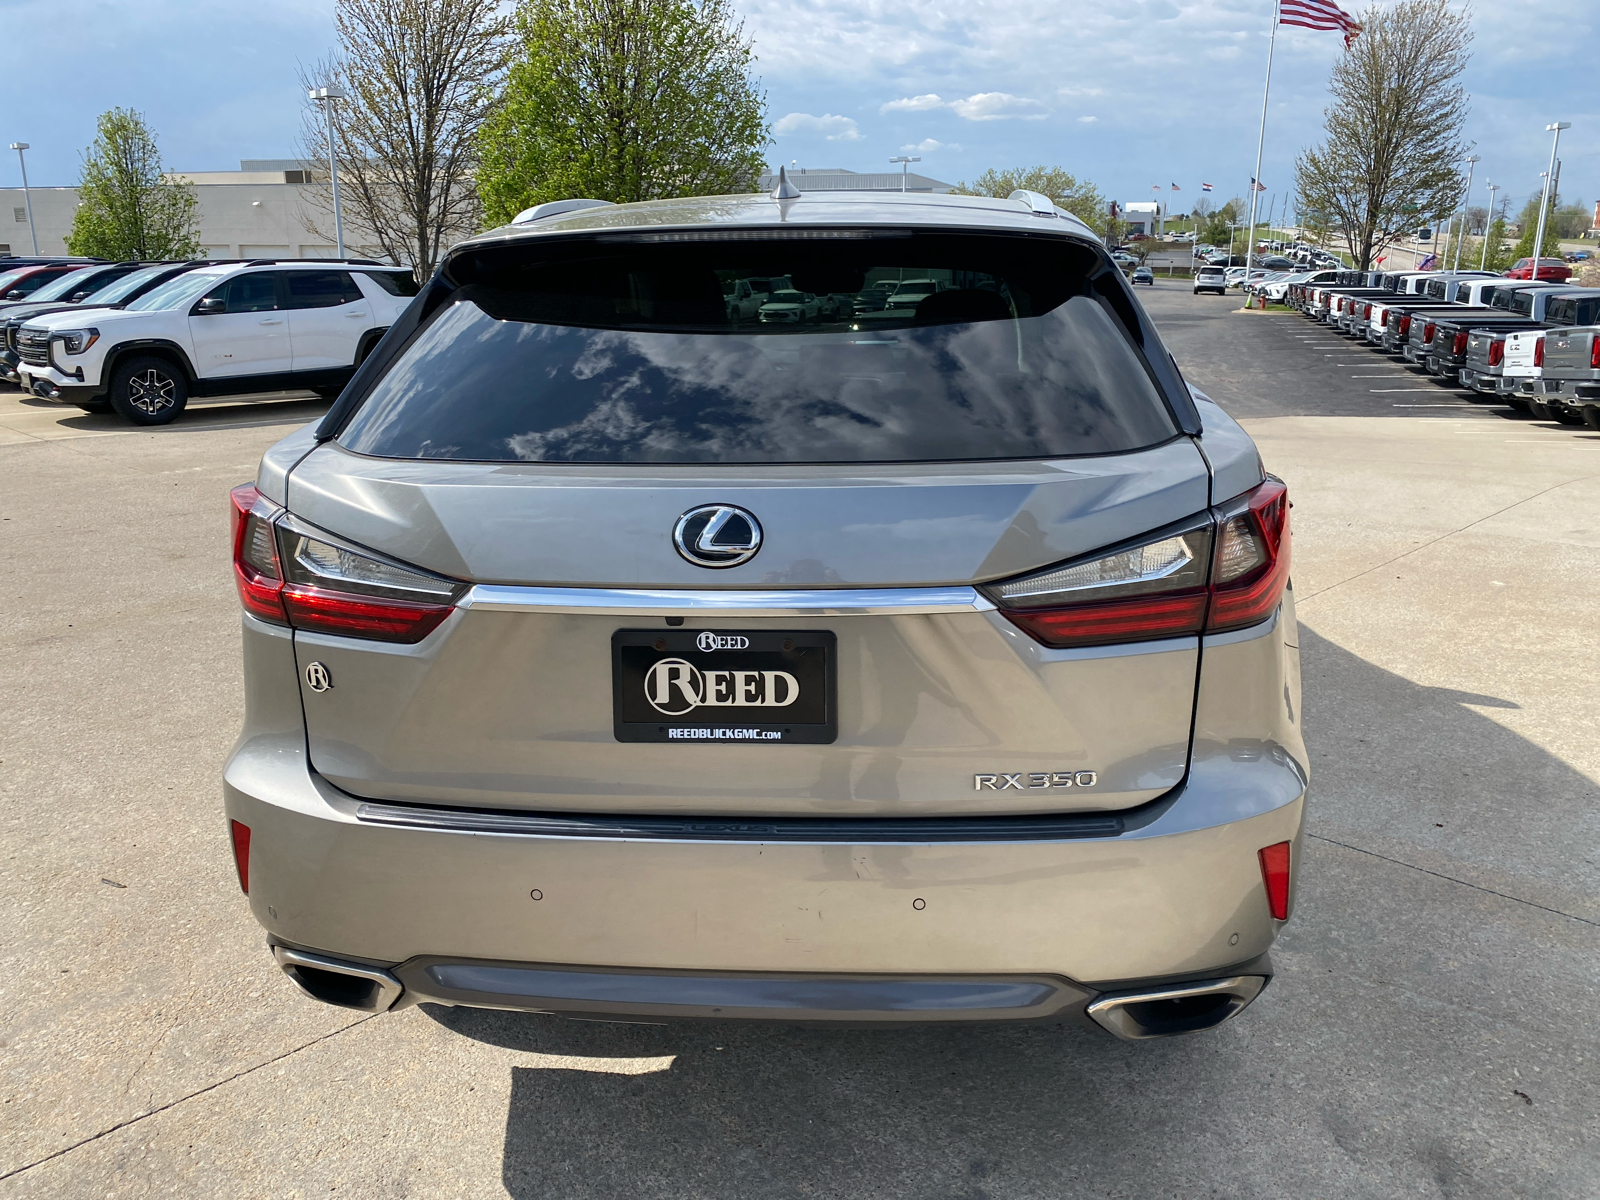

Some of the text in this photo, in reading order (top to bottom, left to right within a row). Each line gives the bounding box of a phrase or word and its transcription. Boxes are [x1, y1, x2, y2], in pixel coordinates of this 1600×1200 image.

[697, 631, 750, 652] REED
[305, 661, 331, 692] R
[644, 657, 800, 716] REED
[974, 770, 1098, 791] RX 350
[691, 824, 769, 832] LEXUS
